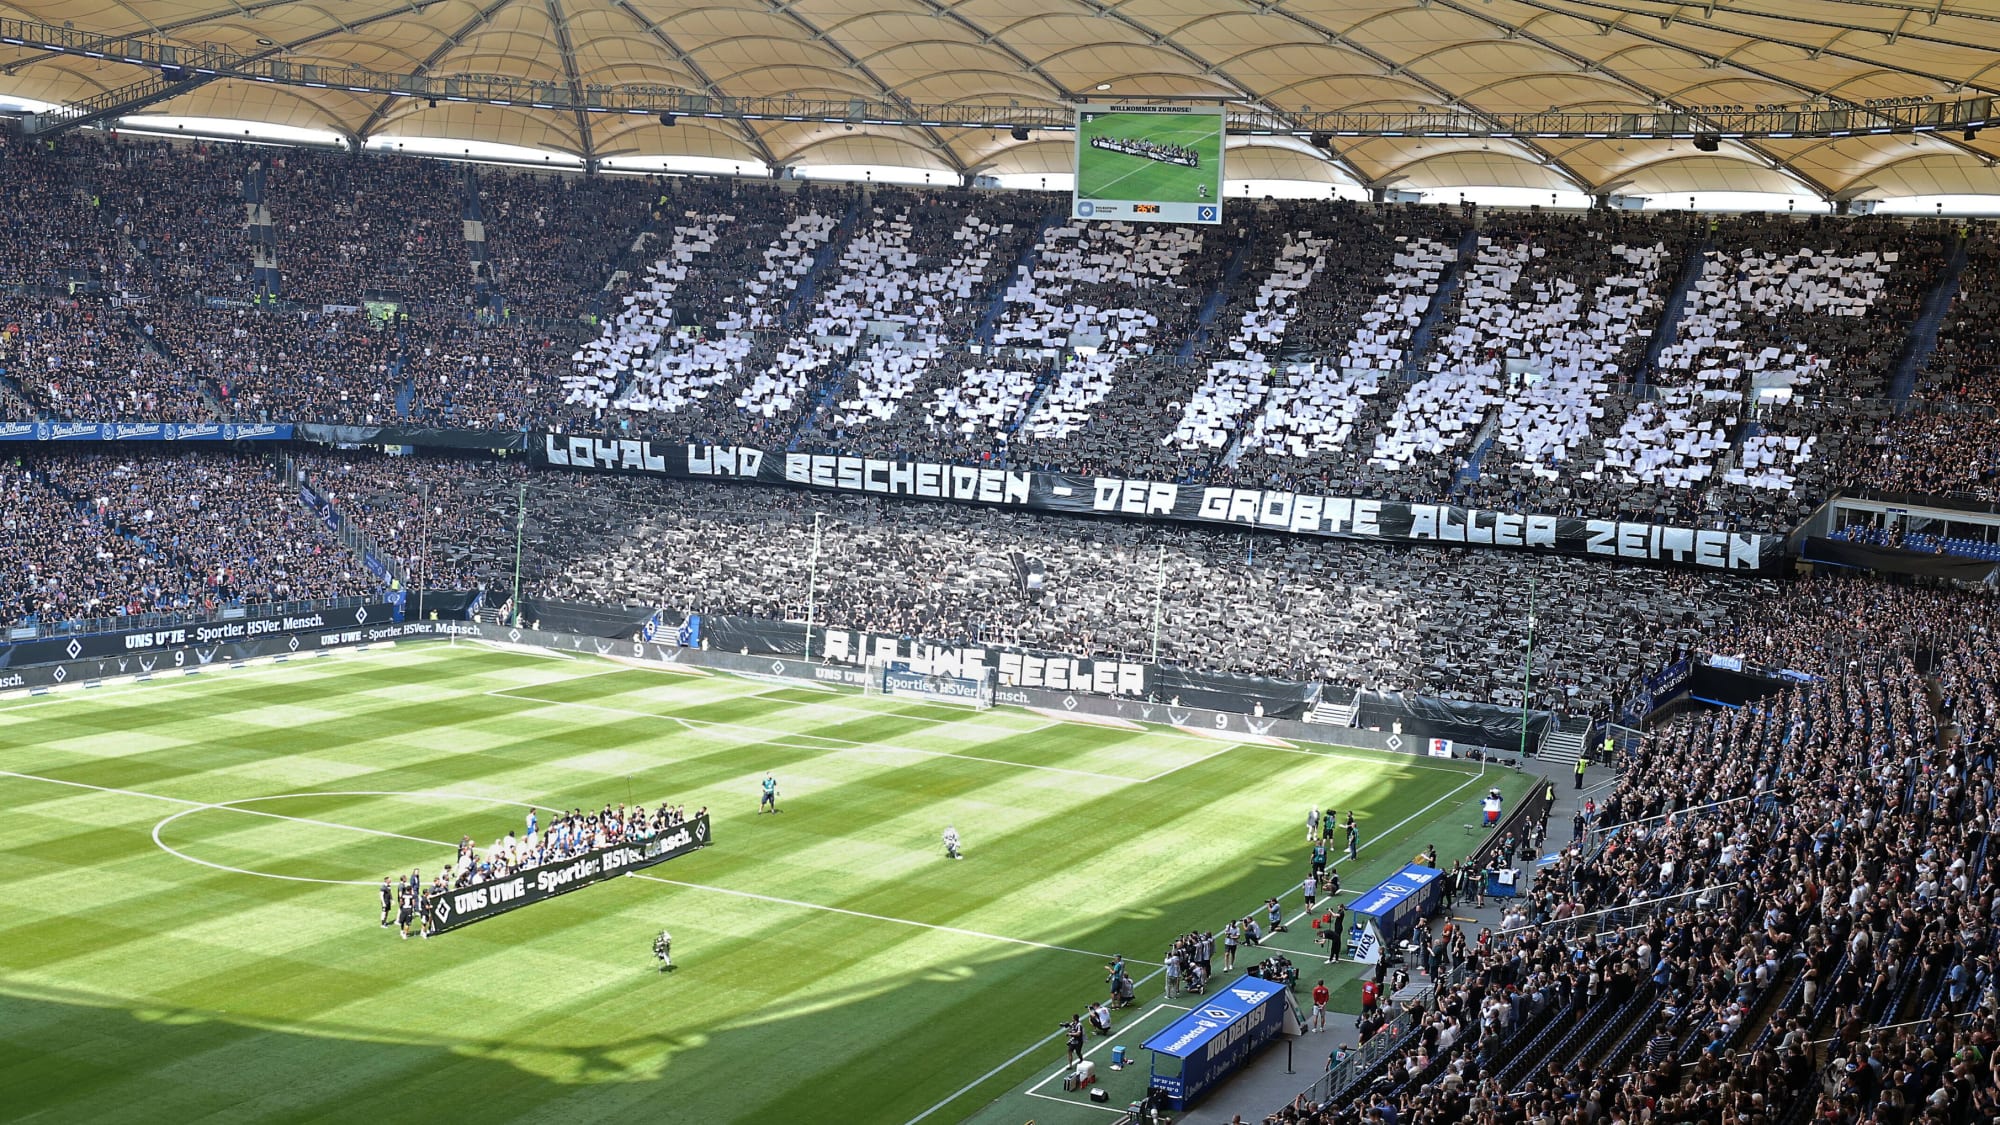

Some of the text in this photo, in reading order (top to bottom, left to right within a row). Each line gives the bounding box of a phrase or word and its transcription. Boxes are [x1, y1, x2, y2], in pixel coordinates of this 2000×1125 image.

[546, 433, 665, 472] LOYAL
[688, 443, 764, 477] UND
[786, 452, 1031, 505] BESCHEIDEN
[1093, 477, 1179, 516] DER
[1408, 503, 1557, 549] ALLER
[1585, 518, 1762, 570] ZEITEN
[125, 633, 153, 649] UNS
[196, 624, 245, 641] Sportler.
[247, 619, 281, 635] HSVer.
[283, 613, 324, 629] Mensch.
[321, 634, 340, 645] UNS
[341, 631, 361, 642] UWE
[368, 628, 402, 641] Sportler.
[403, 623, 433, 634] HSVer.
[435, 622, 482, 636] Mensch.
[175, 650, 185, 667] 9
[633, 643, 644, 658] 9
[816, 667, 842, 680] UNS
[886, 676, 937, 693] Sportler.
[940, 682, 978, 697] HSVer.
[910, 641, 986, 681] UWE
[998, 652, 1145, 696] SEELER
[1215, 713, 1228, 730] 9
[454, 888, 488, 914] UNS
[489, 877, 526, 904] UWE
[537, 858, 600, 893] Sportler.
[1206, 1002, 1268, 1062] NUR DER HSV
